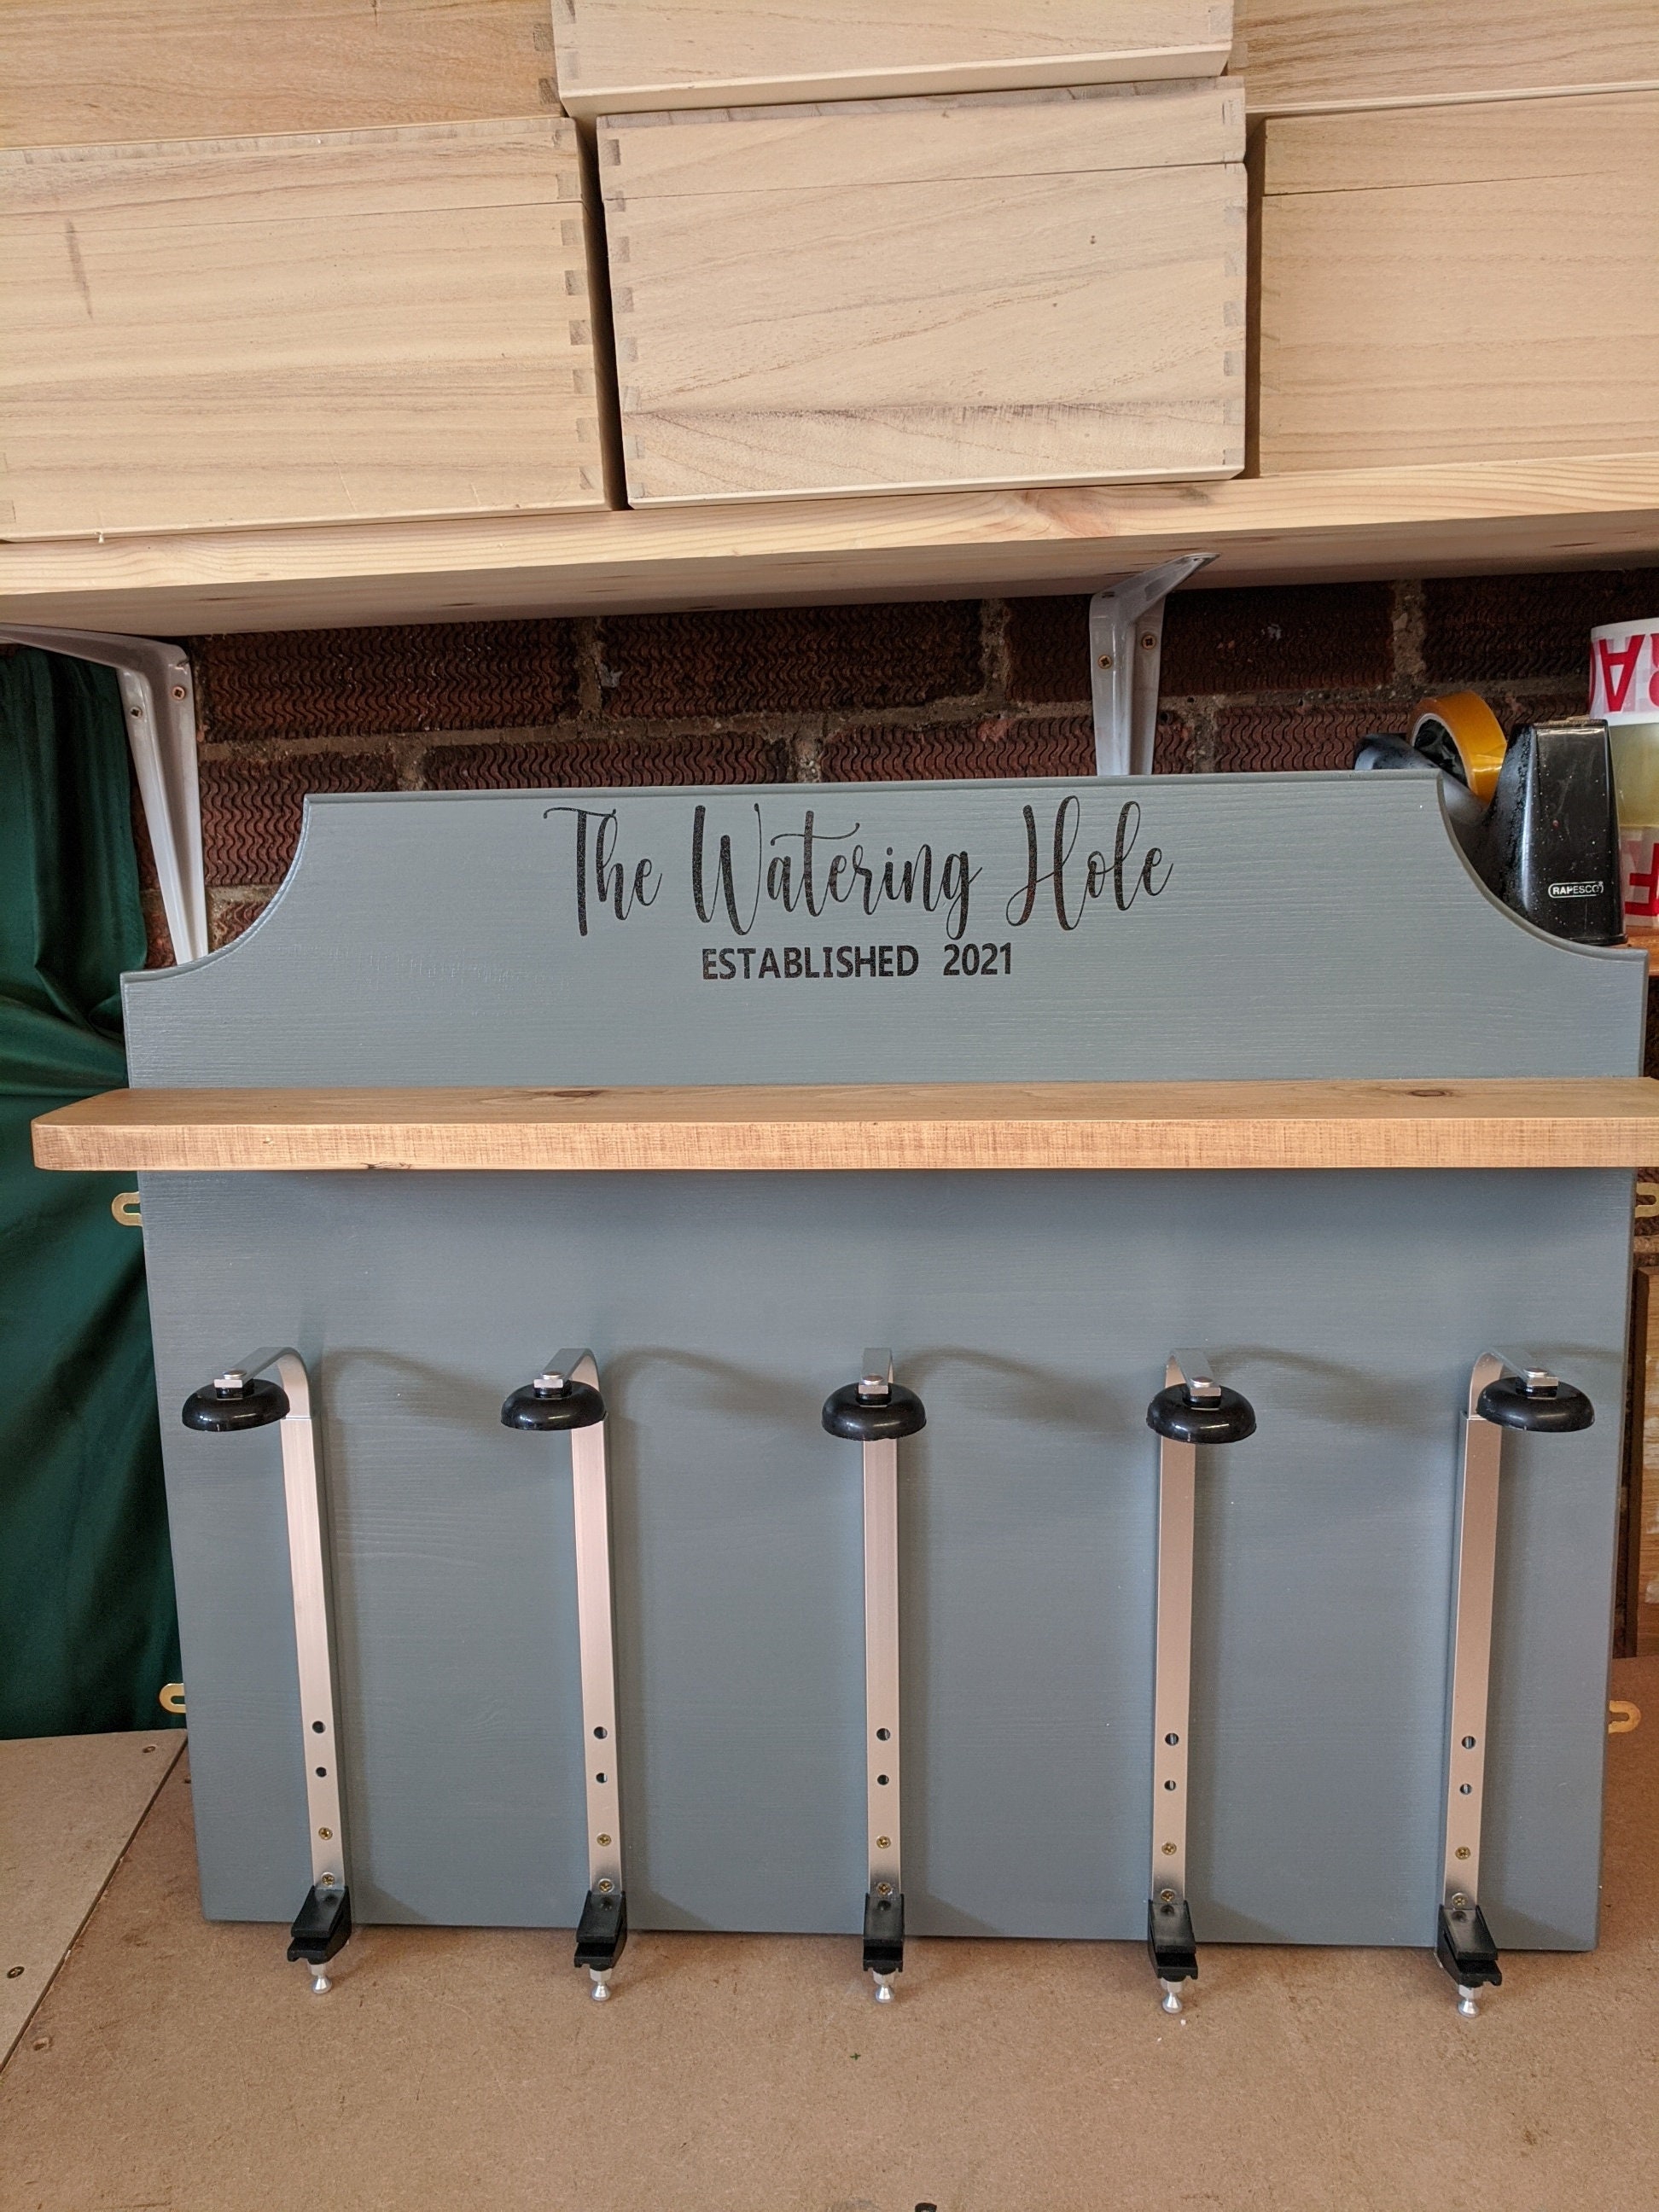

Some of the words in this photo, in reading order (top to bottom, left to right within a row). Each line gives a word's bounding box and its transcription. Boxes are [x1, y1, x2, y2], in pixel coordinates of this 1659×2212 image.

[543, 807, 662, 936] The
[691, 803, 982, 940] Watering
[1006, 795, 1174, 931] Hole
[1552, 884, 1600, 895] RAPESCO
[702, 945, 919, 980] ESTABLISHED
[943, 942, 1012, 975] 2021
